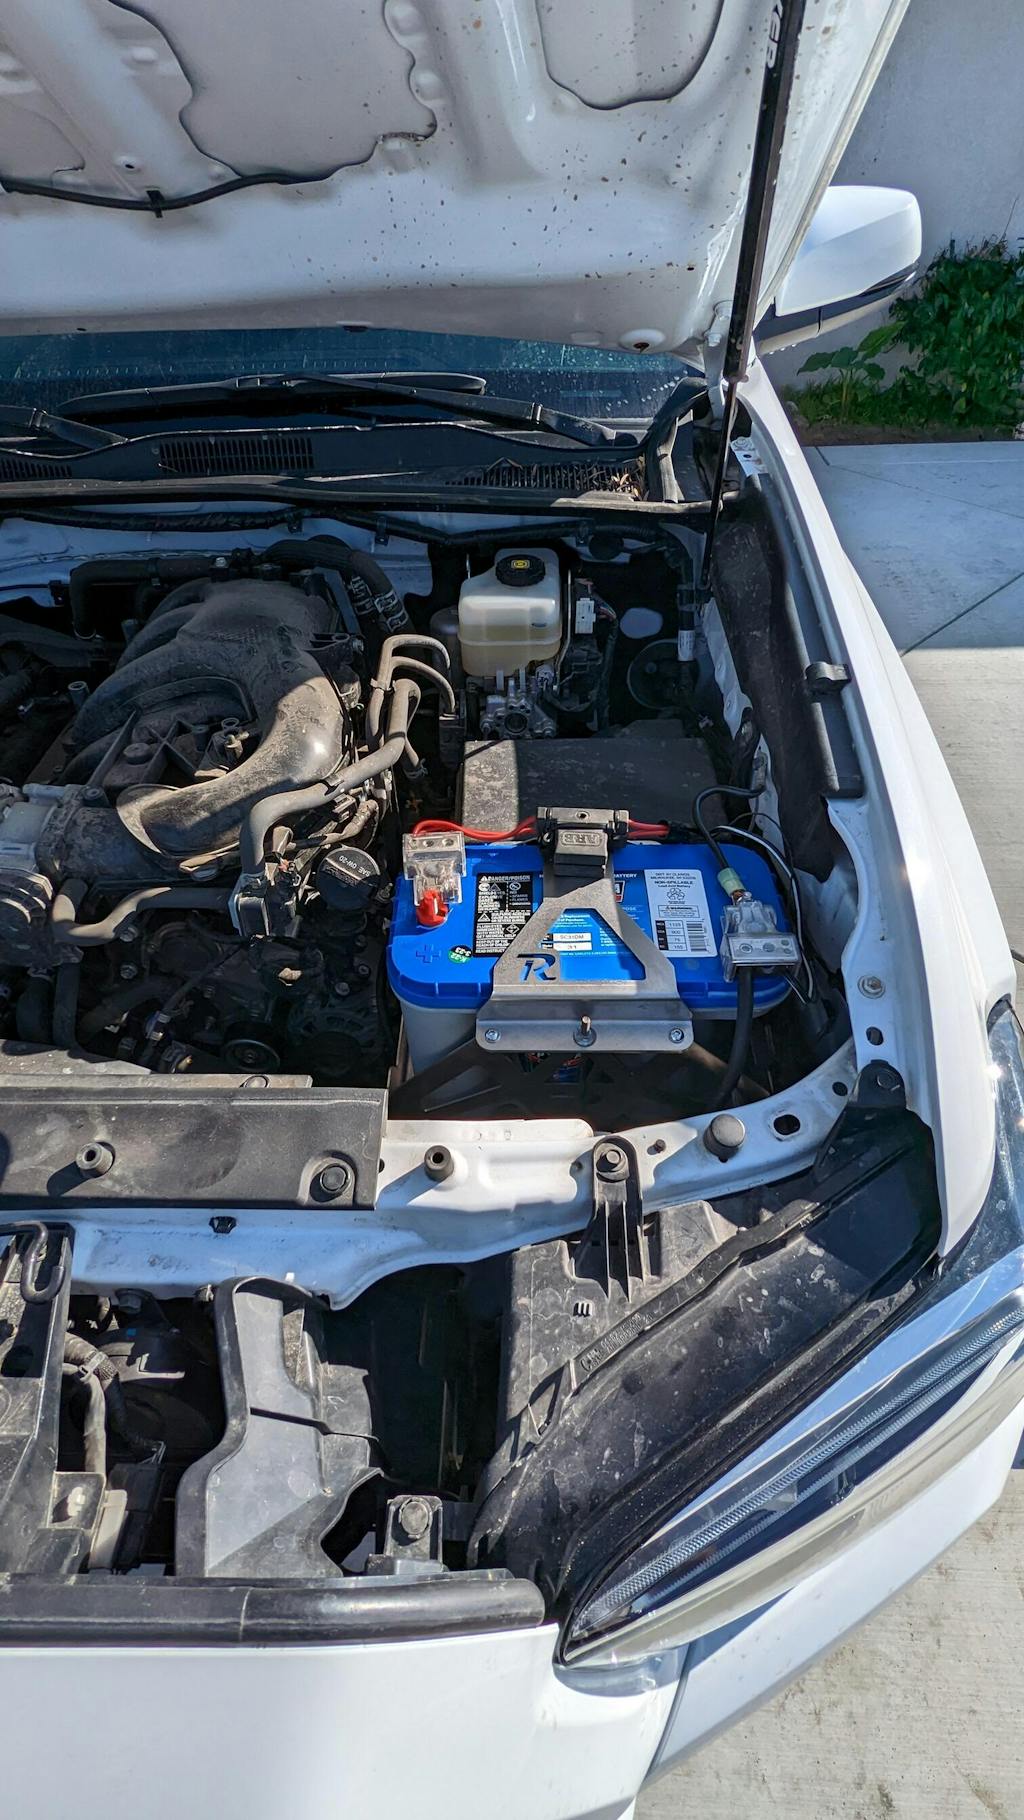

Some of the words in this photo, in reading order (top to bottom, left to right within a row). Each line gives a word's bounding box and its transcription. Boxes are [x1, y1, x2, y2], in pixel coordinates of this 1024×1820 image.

[766, 0, 783, 69] ER
[339, 855, 357, 870] 0W-20
[358, 866, 371, 877] SAE
[517, 953, 556, 981] R
